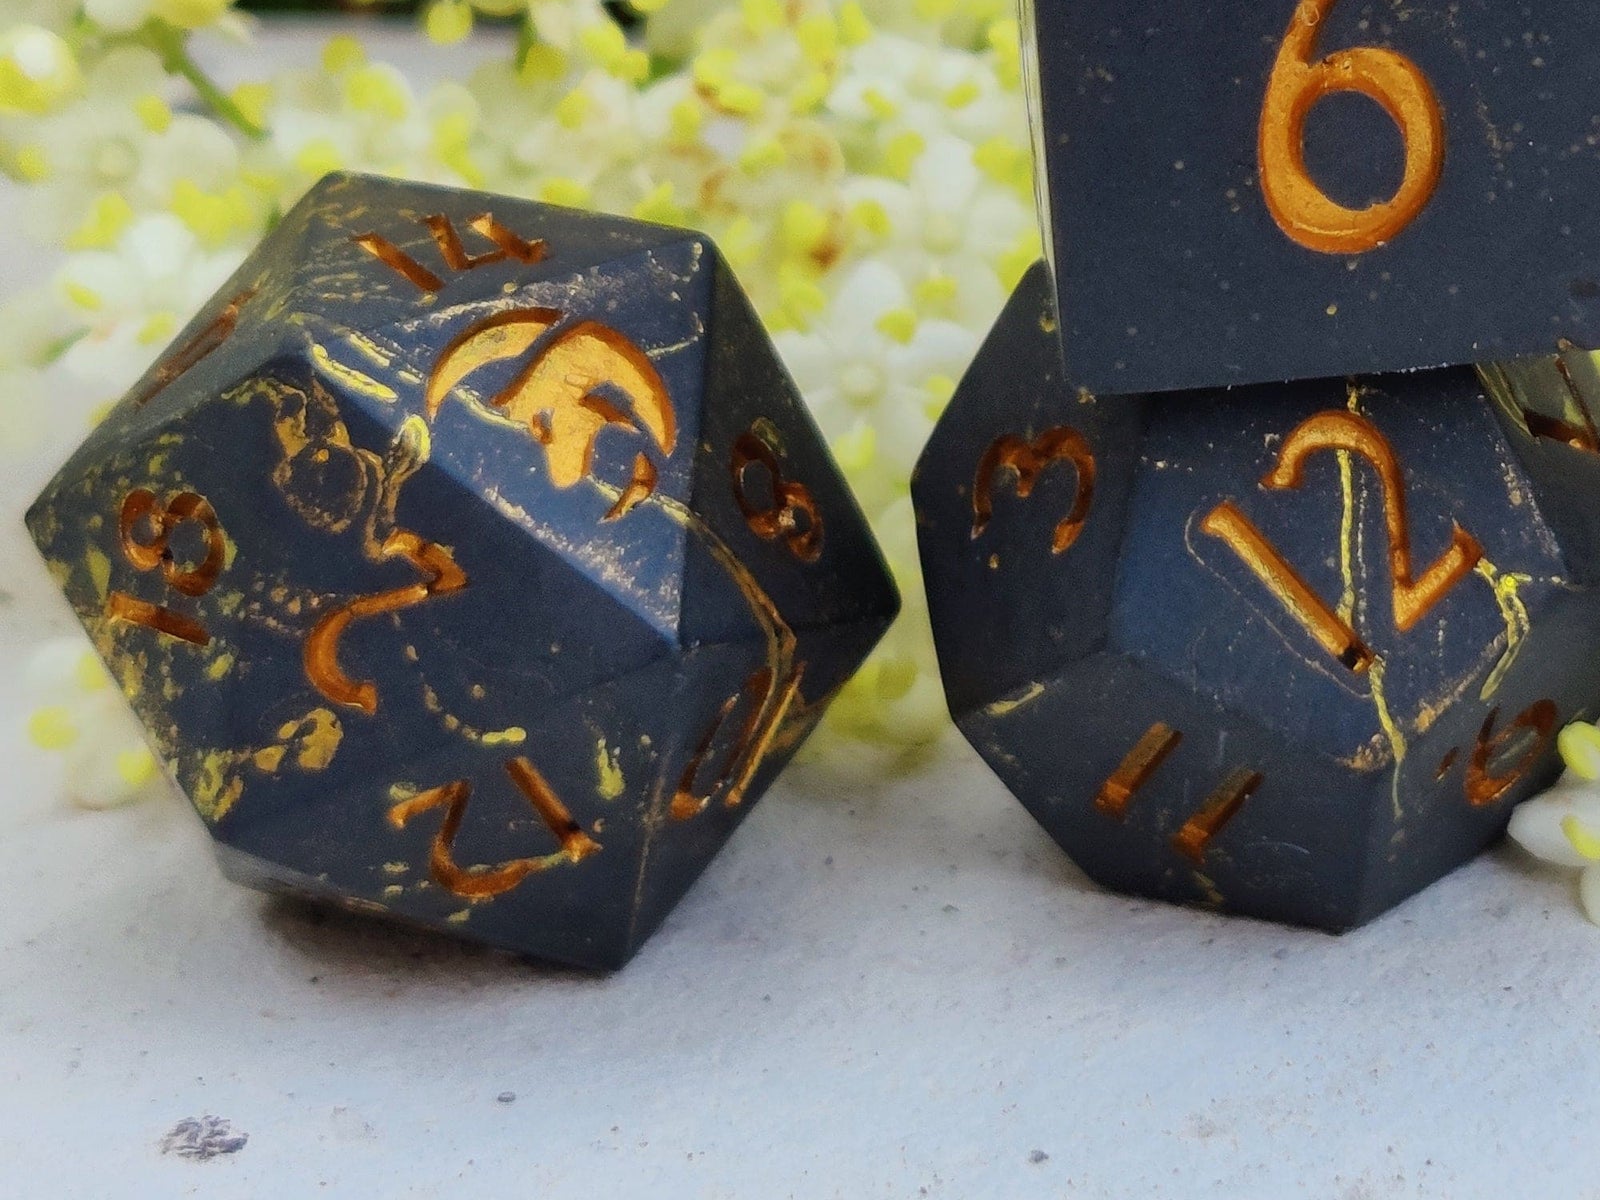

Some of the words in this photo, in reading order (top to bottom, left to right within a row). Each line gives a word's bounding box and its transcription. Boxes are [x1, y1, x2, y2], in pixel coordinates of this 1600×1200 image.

[354, 211, 548, 292] 14
[970, 426, 1097, 556] 3
[1200, 412, 1484, 675] 12
[106, 490, 230, 648] 18
[1093, 720, 1263, 864] 11
